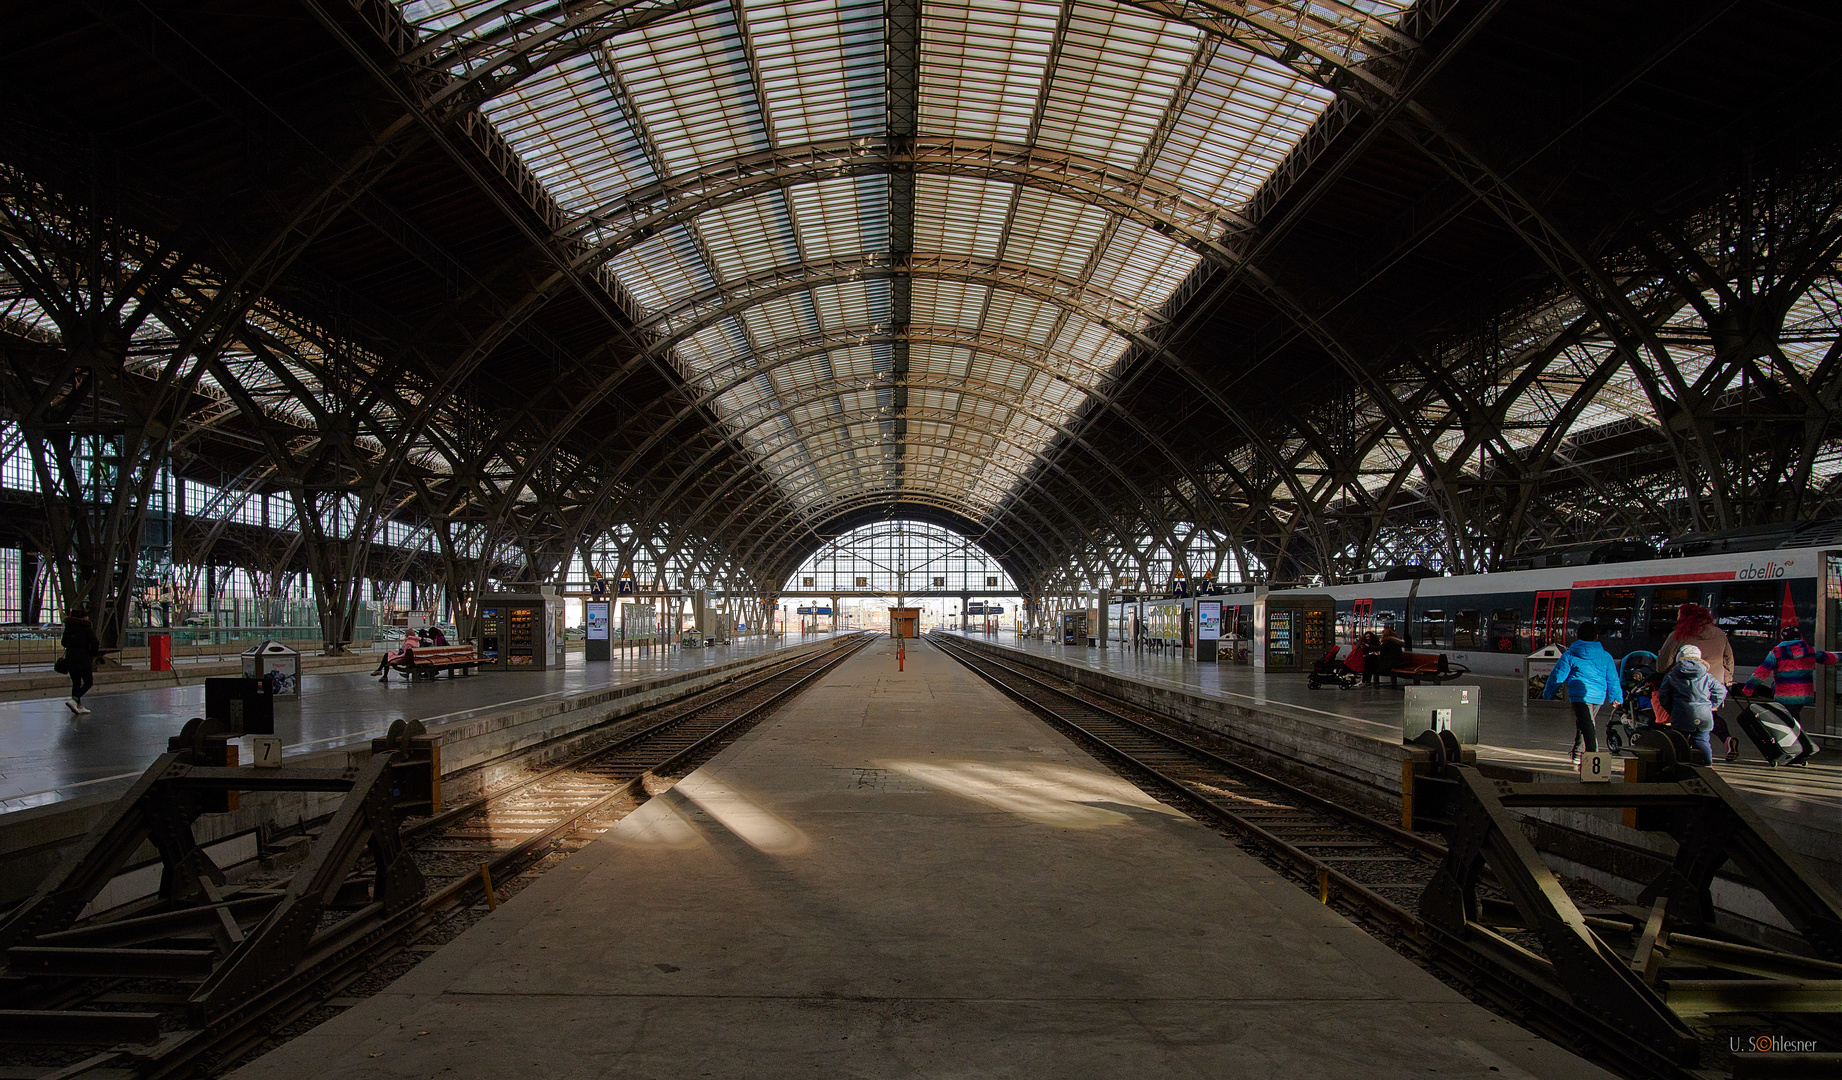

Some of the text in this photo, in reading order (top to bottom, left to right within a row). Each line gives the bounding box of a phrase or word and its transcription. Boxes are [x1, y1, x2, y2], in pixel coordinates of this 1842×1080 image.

[1739, 562, 1785, 580] abellio
[592, 581, 601, 592] A
[622, 581, 631, 592] A
[1174, 581, 1183, 592] A
[1206, 581, 1215, 592] A
[1639, 597, 1646, 611] 2
[1707, 594, 1713, 608] 1
[1483, 617, 1488, 628] 2
[263, 742, 271, 761] 7
[1592, 756, 1601, 775] 8
